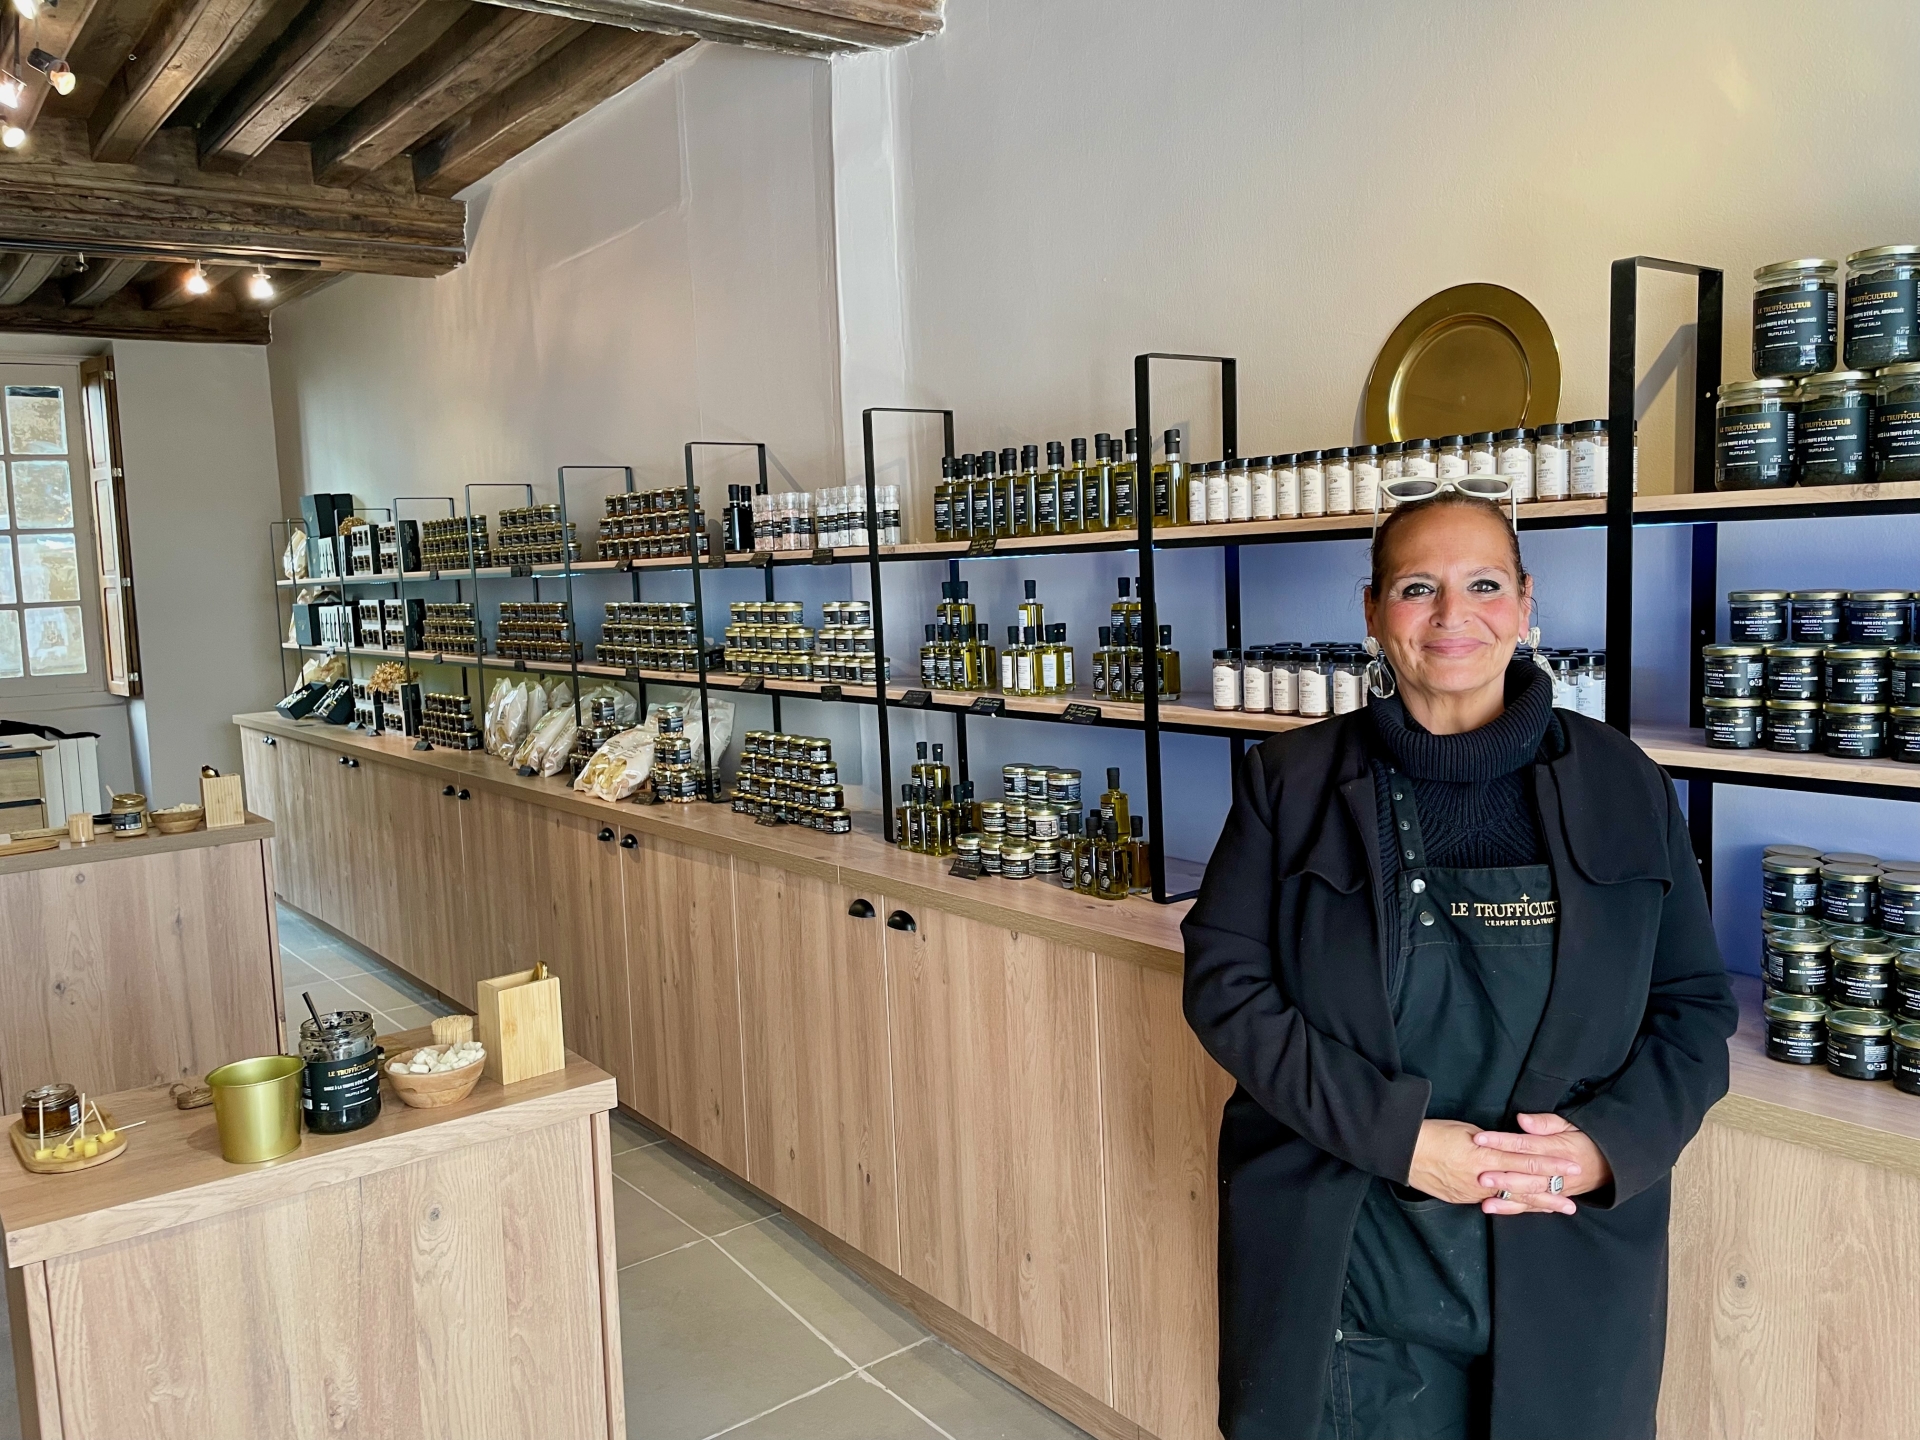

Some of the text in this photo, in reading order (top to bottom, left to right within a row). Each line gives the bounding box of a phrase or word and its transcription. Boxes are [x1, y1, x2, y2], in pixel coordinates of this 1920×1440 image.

[1887, 411, 1920, 421] TRUFFICUL
[1451, 901, 1557, 917] LE TRUFFICULT
